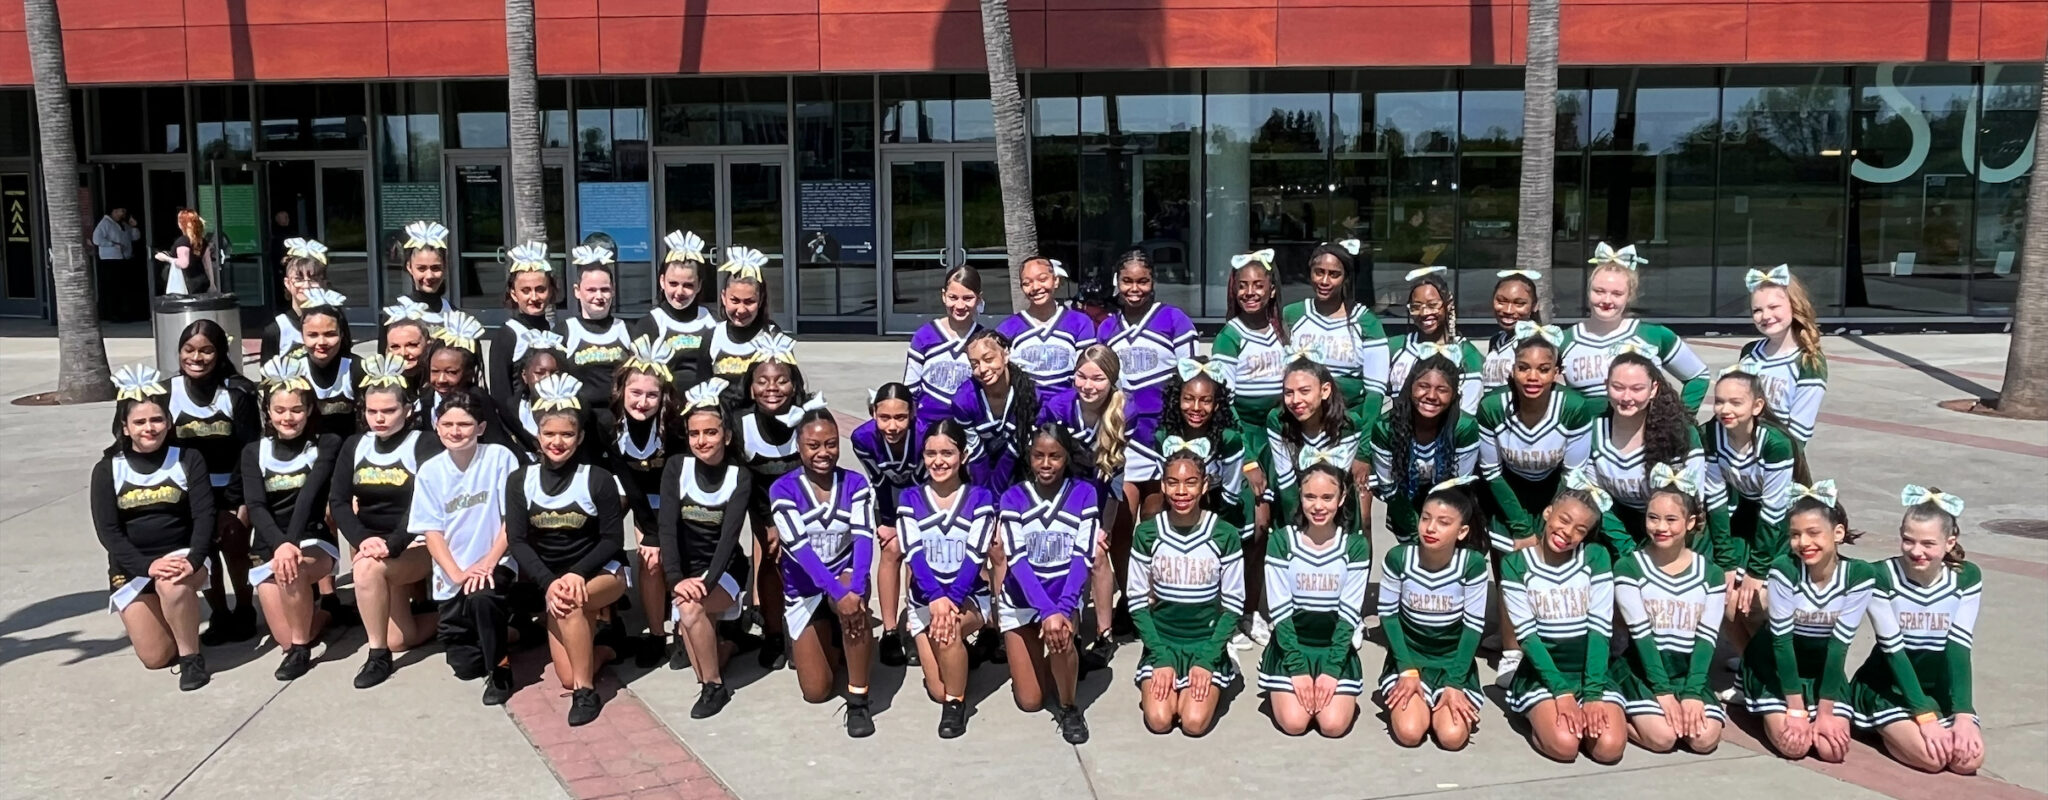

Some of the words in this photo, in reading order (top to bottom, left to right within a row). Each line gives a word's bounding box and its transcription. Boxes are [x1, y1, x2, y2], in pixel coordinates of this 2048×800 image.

[1296, 573, 1340, 592] SPARTANS
[1409, 592, 1455, 611] SPARTANS
[1899, 612, 1950, 631] SPARTANS
